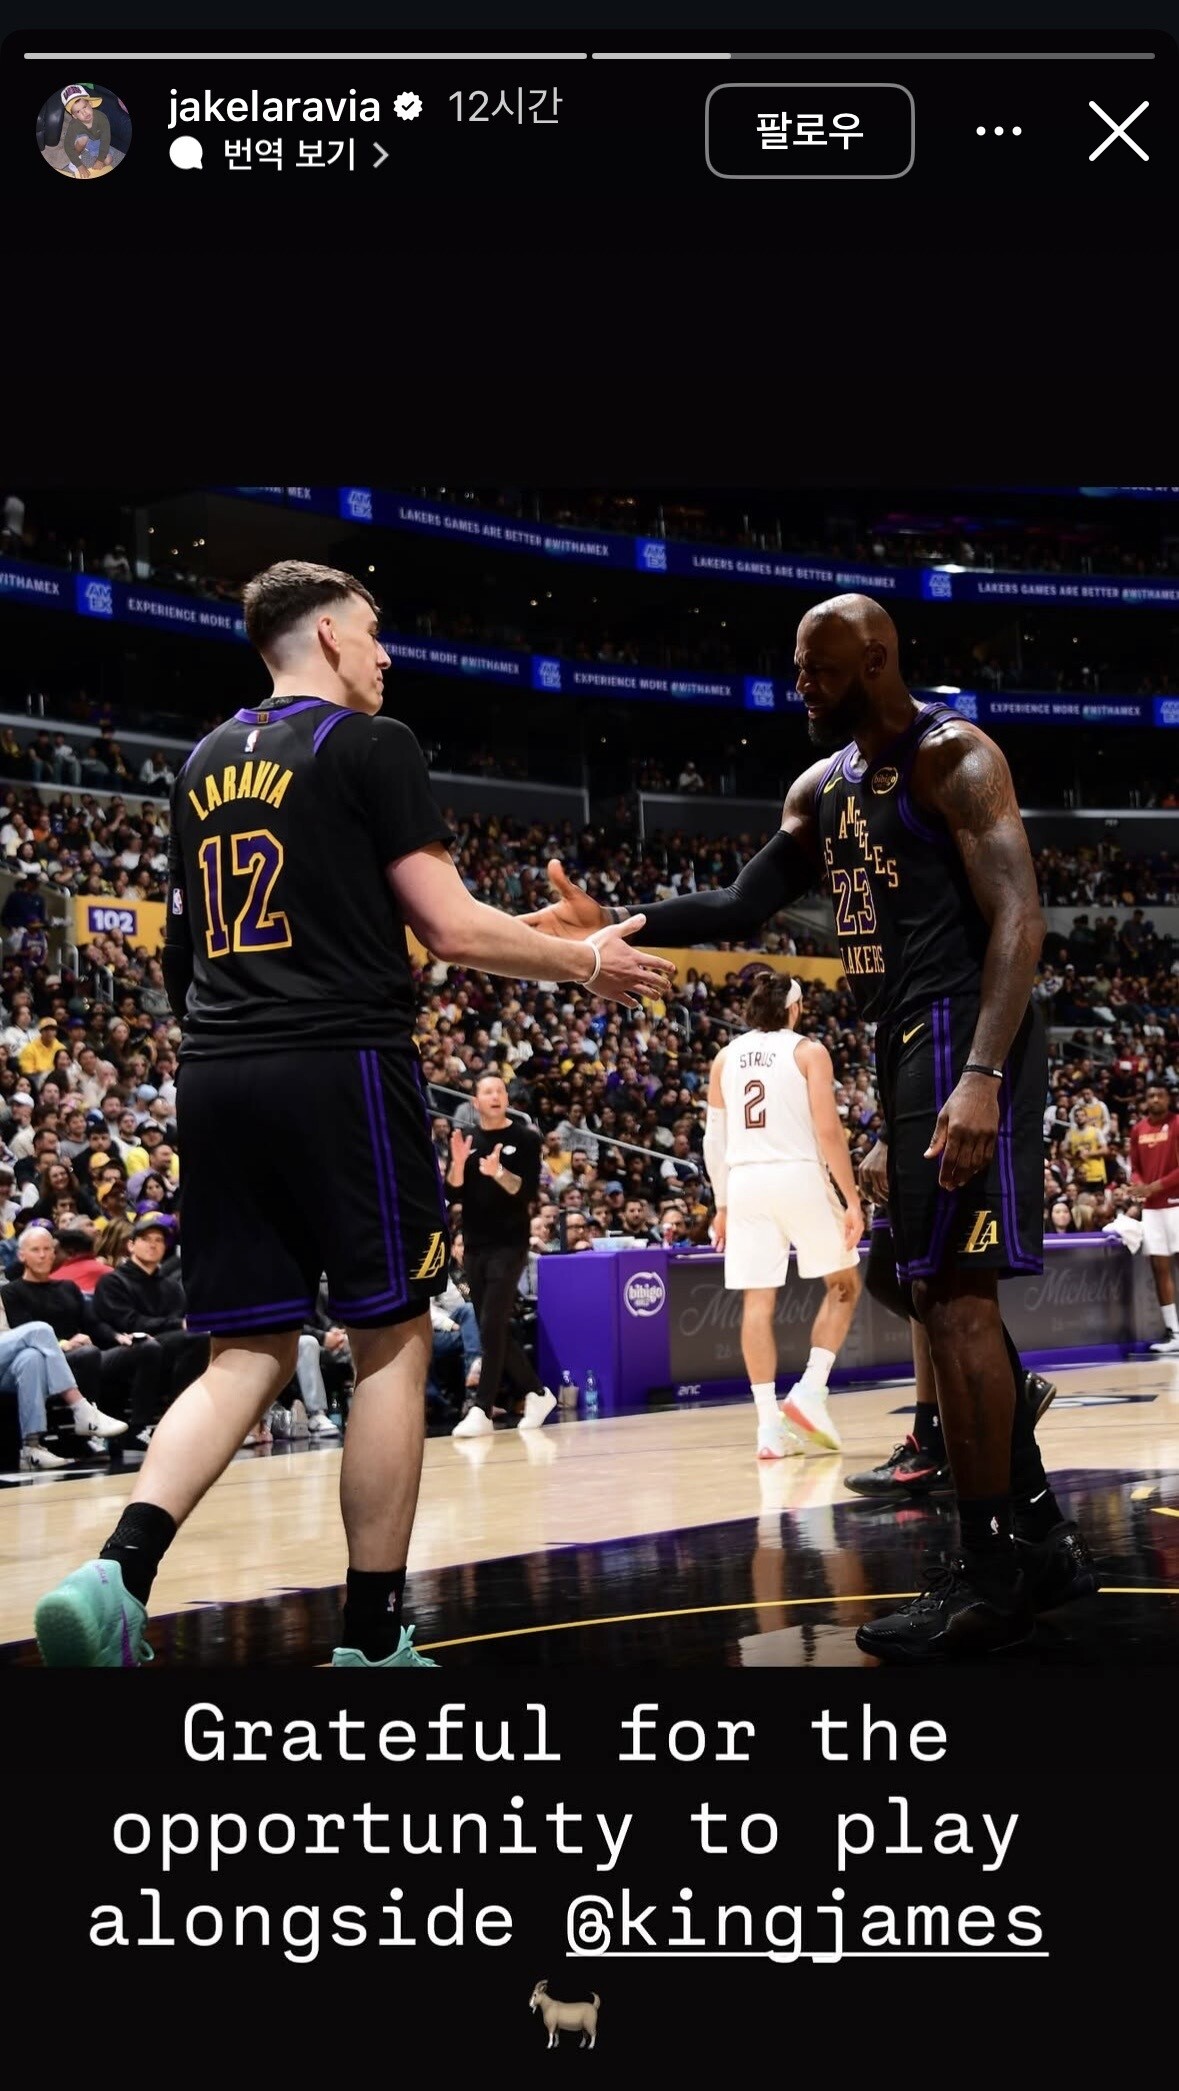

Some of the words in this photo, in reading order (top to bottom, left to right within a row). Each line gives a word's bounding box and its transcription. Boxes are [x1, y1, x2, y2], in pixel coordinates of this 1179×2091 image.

[400, 507, 441, 526] LAKERS
[443, 516, 481, 534] GAMES
[483, 524, 503, 539] ARE
[505, 528, 542, 547] BETTER
[544, 537, 610, 556] #WITHAMEX
[693, 555, 734, 571] LAKERS
[736, 560, 772, 576] GAMES
[774, 565, 794, 578] ARE
[796, 567, 833, 582] BETTER
[978, 582, 1018, 595] LAKERS
[1020, 583, 1056, 596] GAMES
[1059, 585, 1079, 597] ARE
[1081, 586, 1119, 598] BETTER
[128, 598, 196, 622] EXPERIENCE
[199, 612, 232, 629] MORE
[429, 650, 459, 665] MORE
[573, 671, 637, 689] EXPERIENCE
[639, 679, 668, 691] MORE
[990, 702, 1051, 715] EXPERIENCE
[1052, 703, 1081, 715] MORE
[188, 760, 294, 821] LARAVIA
[839, 796, 899, 888] ANGELES
[199, 829, 293, 959] 12
[832, 867, 877, 936] 23
[93, 908, 135, 934] 102
[840, 947, 885, 974] LAKERS
[739, 1051, 777, 1069] STRUS
[743, 1079, 766, 1130] 2
[957, 1210, 999, 1253] LA
[409, 1231, 446, 1280] LA
[628, 1283, 663, 1304] bibigo
[677, 1384, 702, 1397] anc
